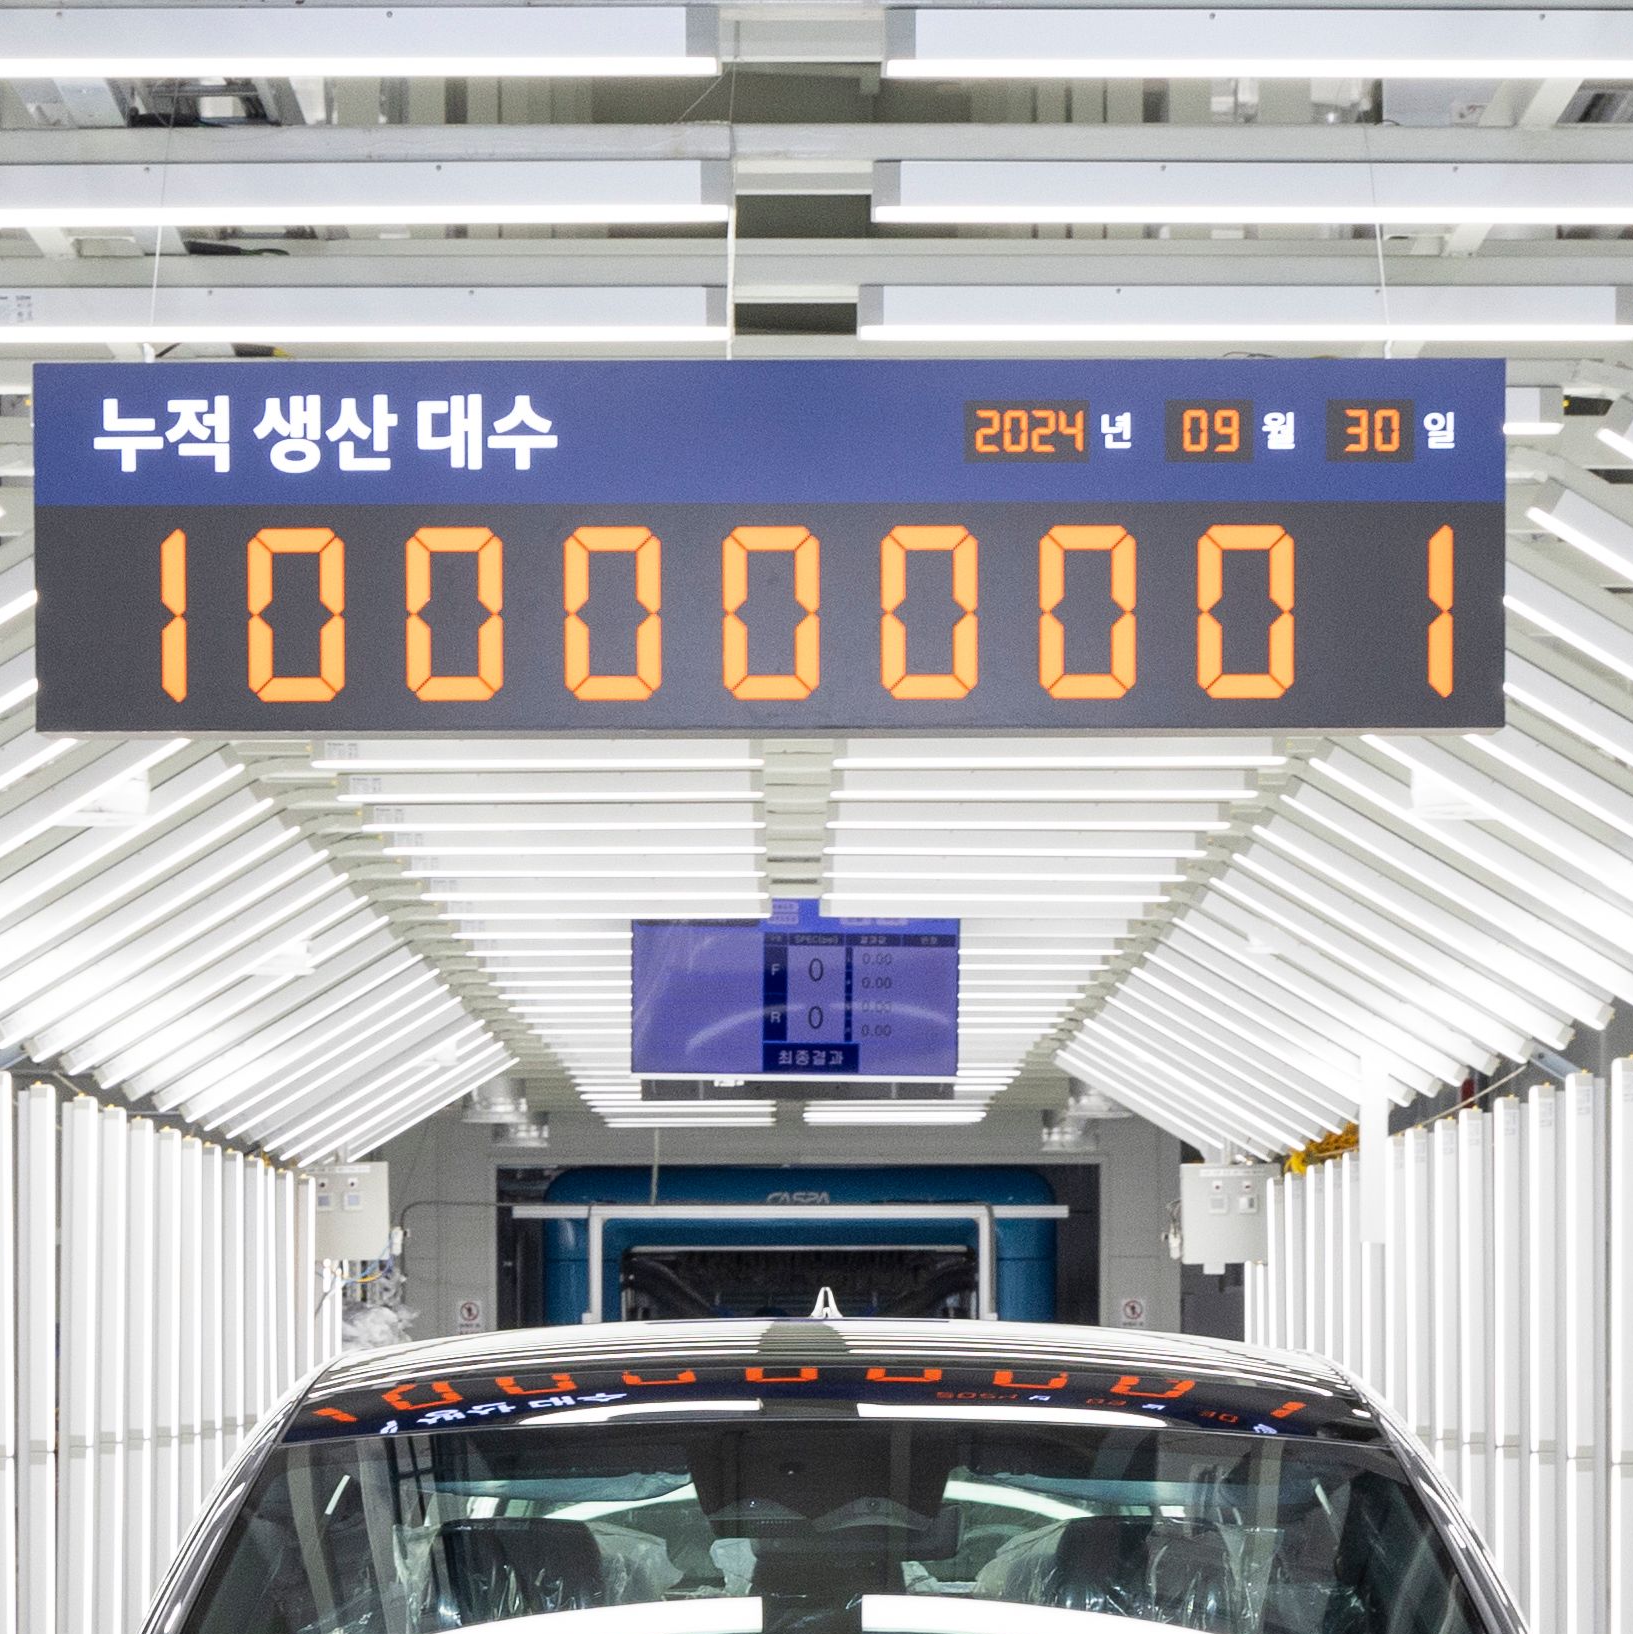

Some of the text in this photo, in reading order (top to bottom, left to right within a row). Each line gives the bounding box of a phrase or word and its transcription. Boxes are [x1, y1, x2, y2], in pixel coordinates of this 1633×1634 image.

[93, 394, 559, 473] 누적 생산 대수
[973, 407, 1456, 455] 2024 년 09 월 30 일
[770, 963, 780, 977] F
[808, 958, 824, 982] 0
[770, 1011, 782, 1024] R
[807, 1005, 824, 1030] 0
[778, 1050, 844, 1066] 최종결과
